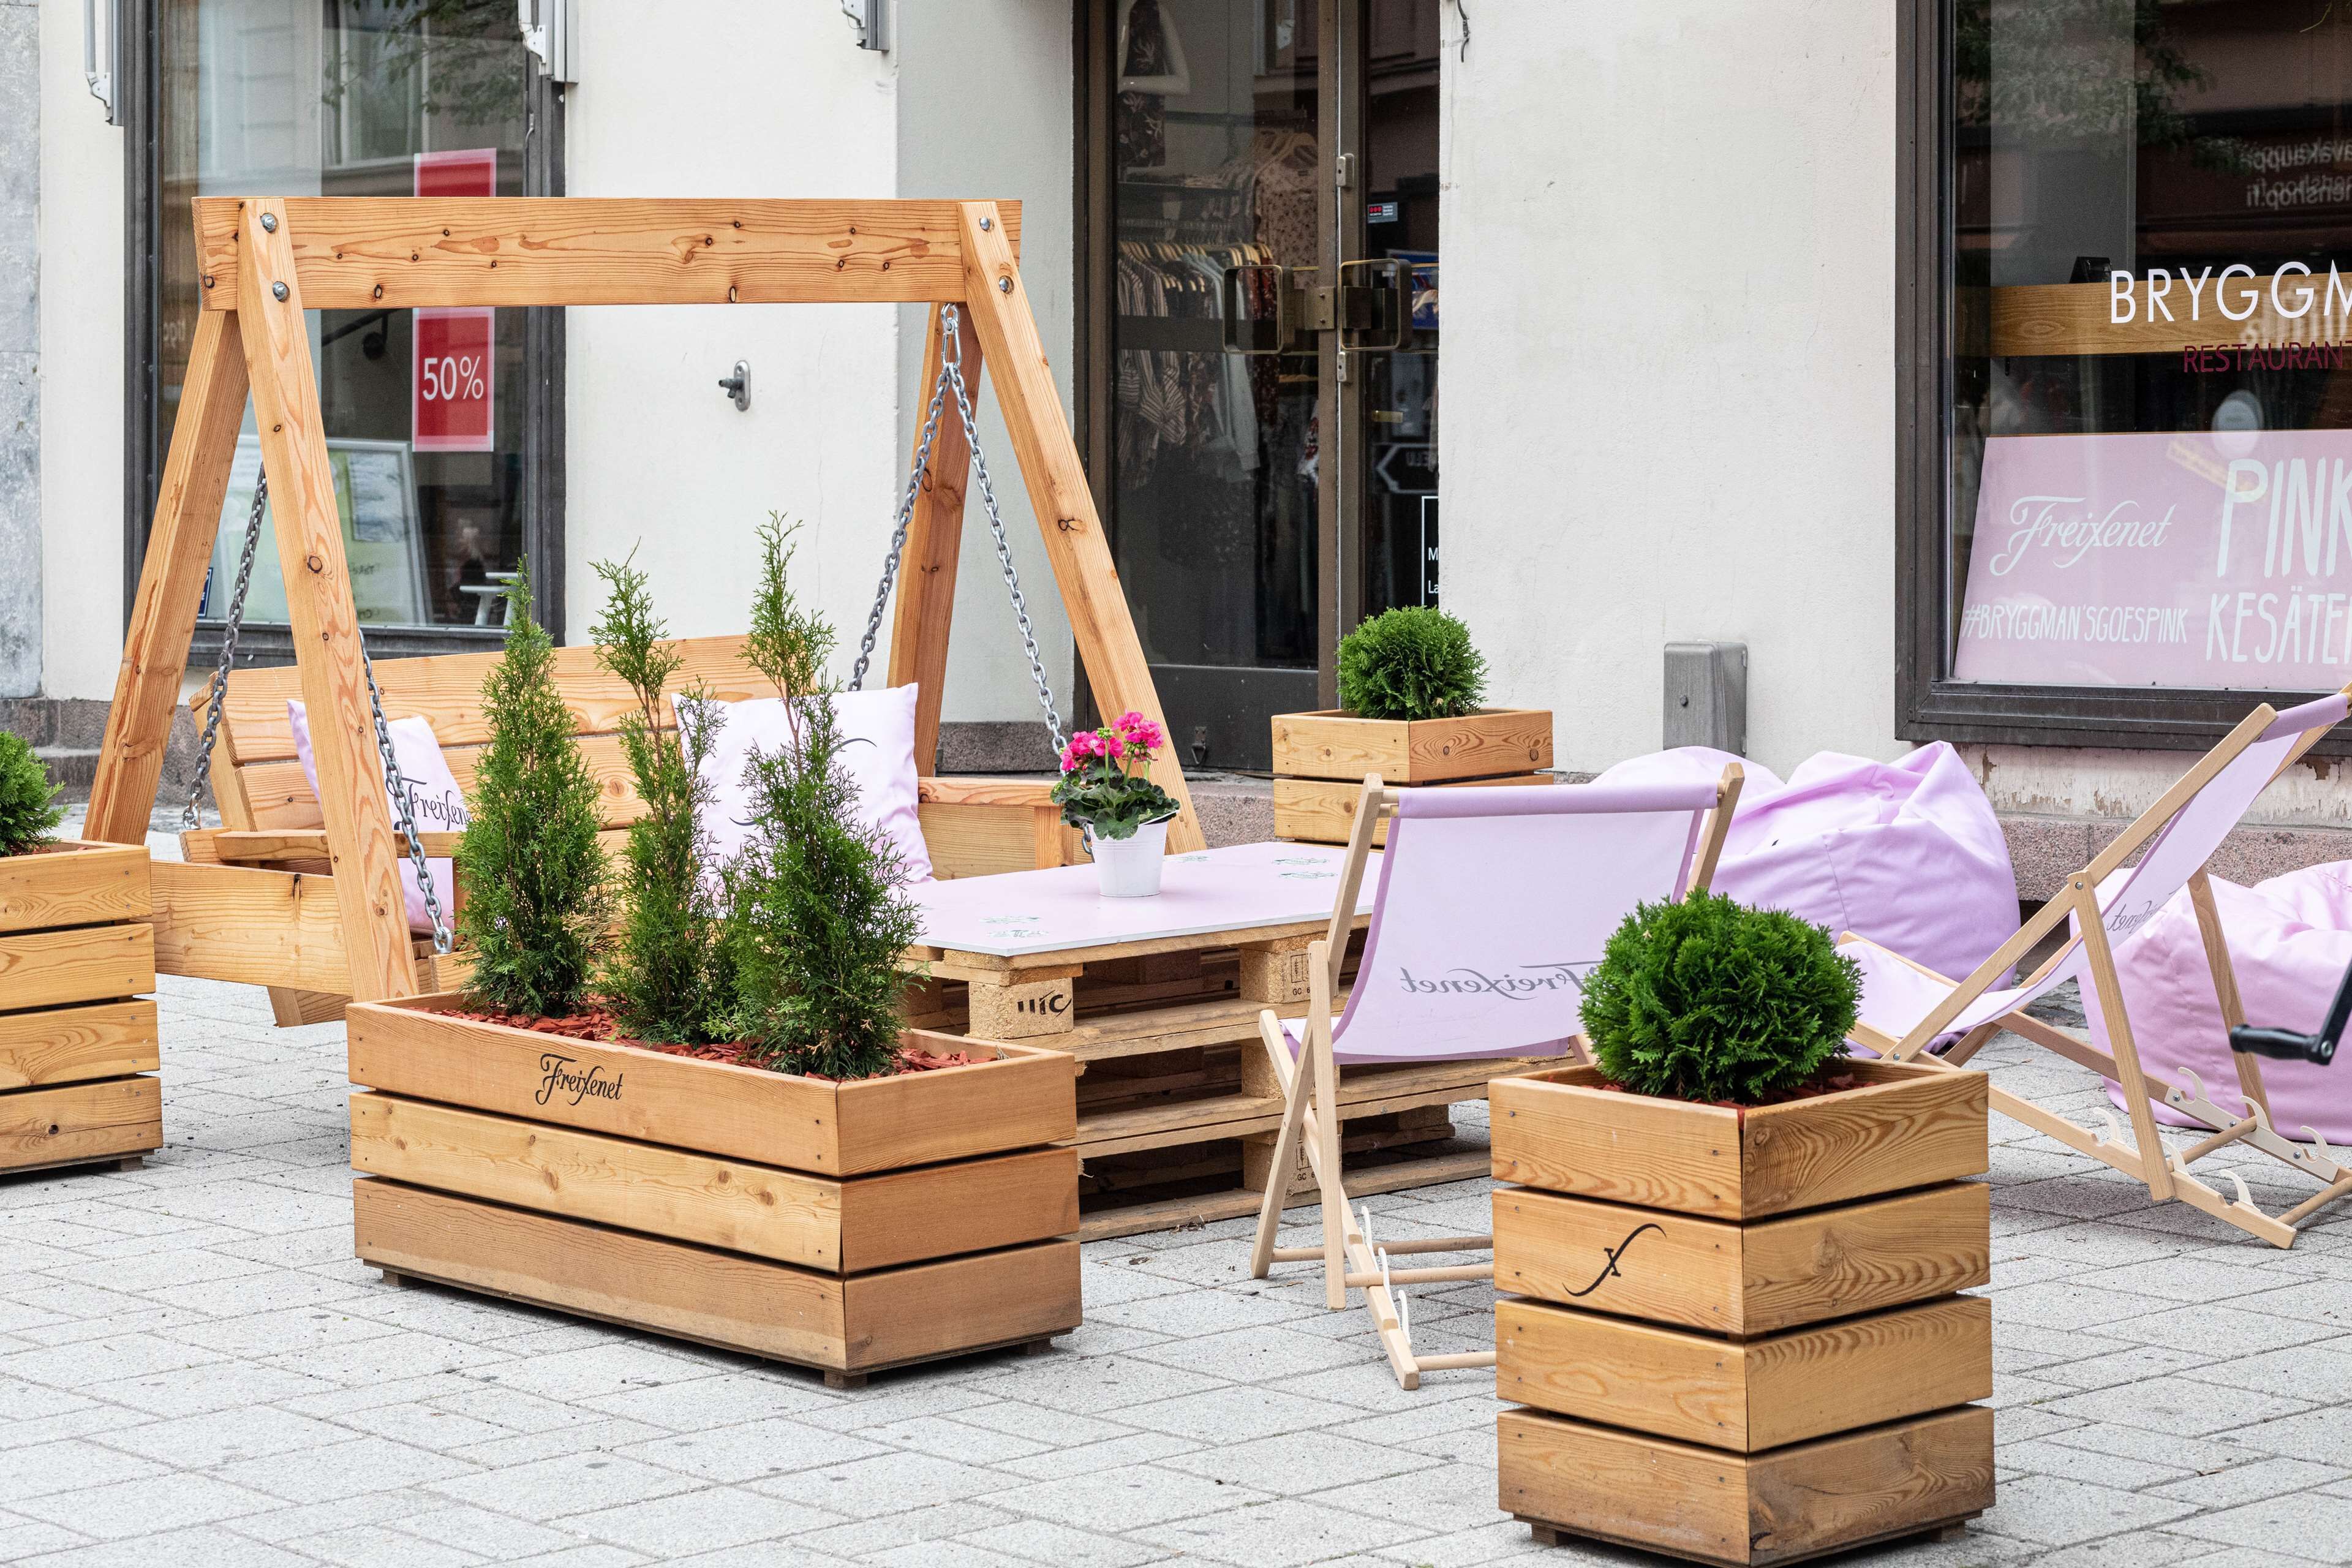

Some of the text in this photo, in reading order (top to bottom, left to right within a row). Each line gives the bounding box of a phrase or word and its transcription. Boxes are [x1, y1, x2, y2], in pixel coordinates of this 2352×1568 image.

[422, 356, 484, 401] 50%
[1989, 496, 2177, 576] Freixenet
[2217, 457, 2352, 578] PINK
[1962, 604, 2188, 643] #BRYGGMAN'SGOESPINK
[2206, 586, 2352, 664] KESÄTE
[535, 1054, 624, 1106] Freixenet
